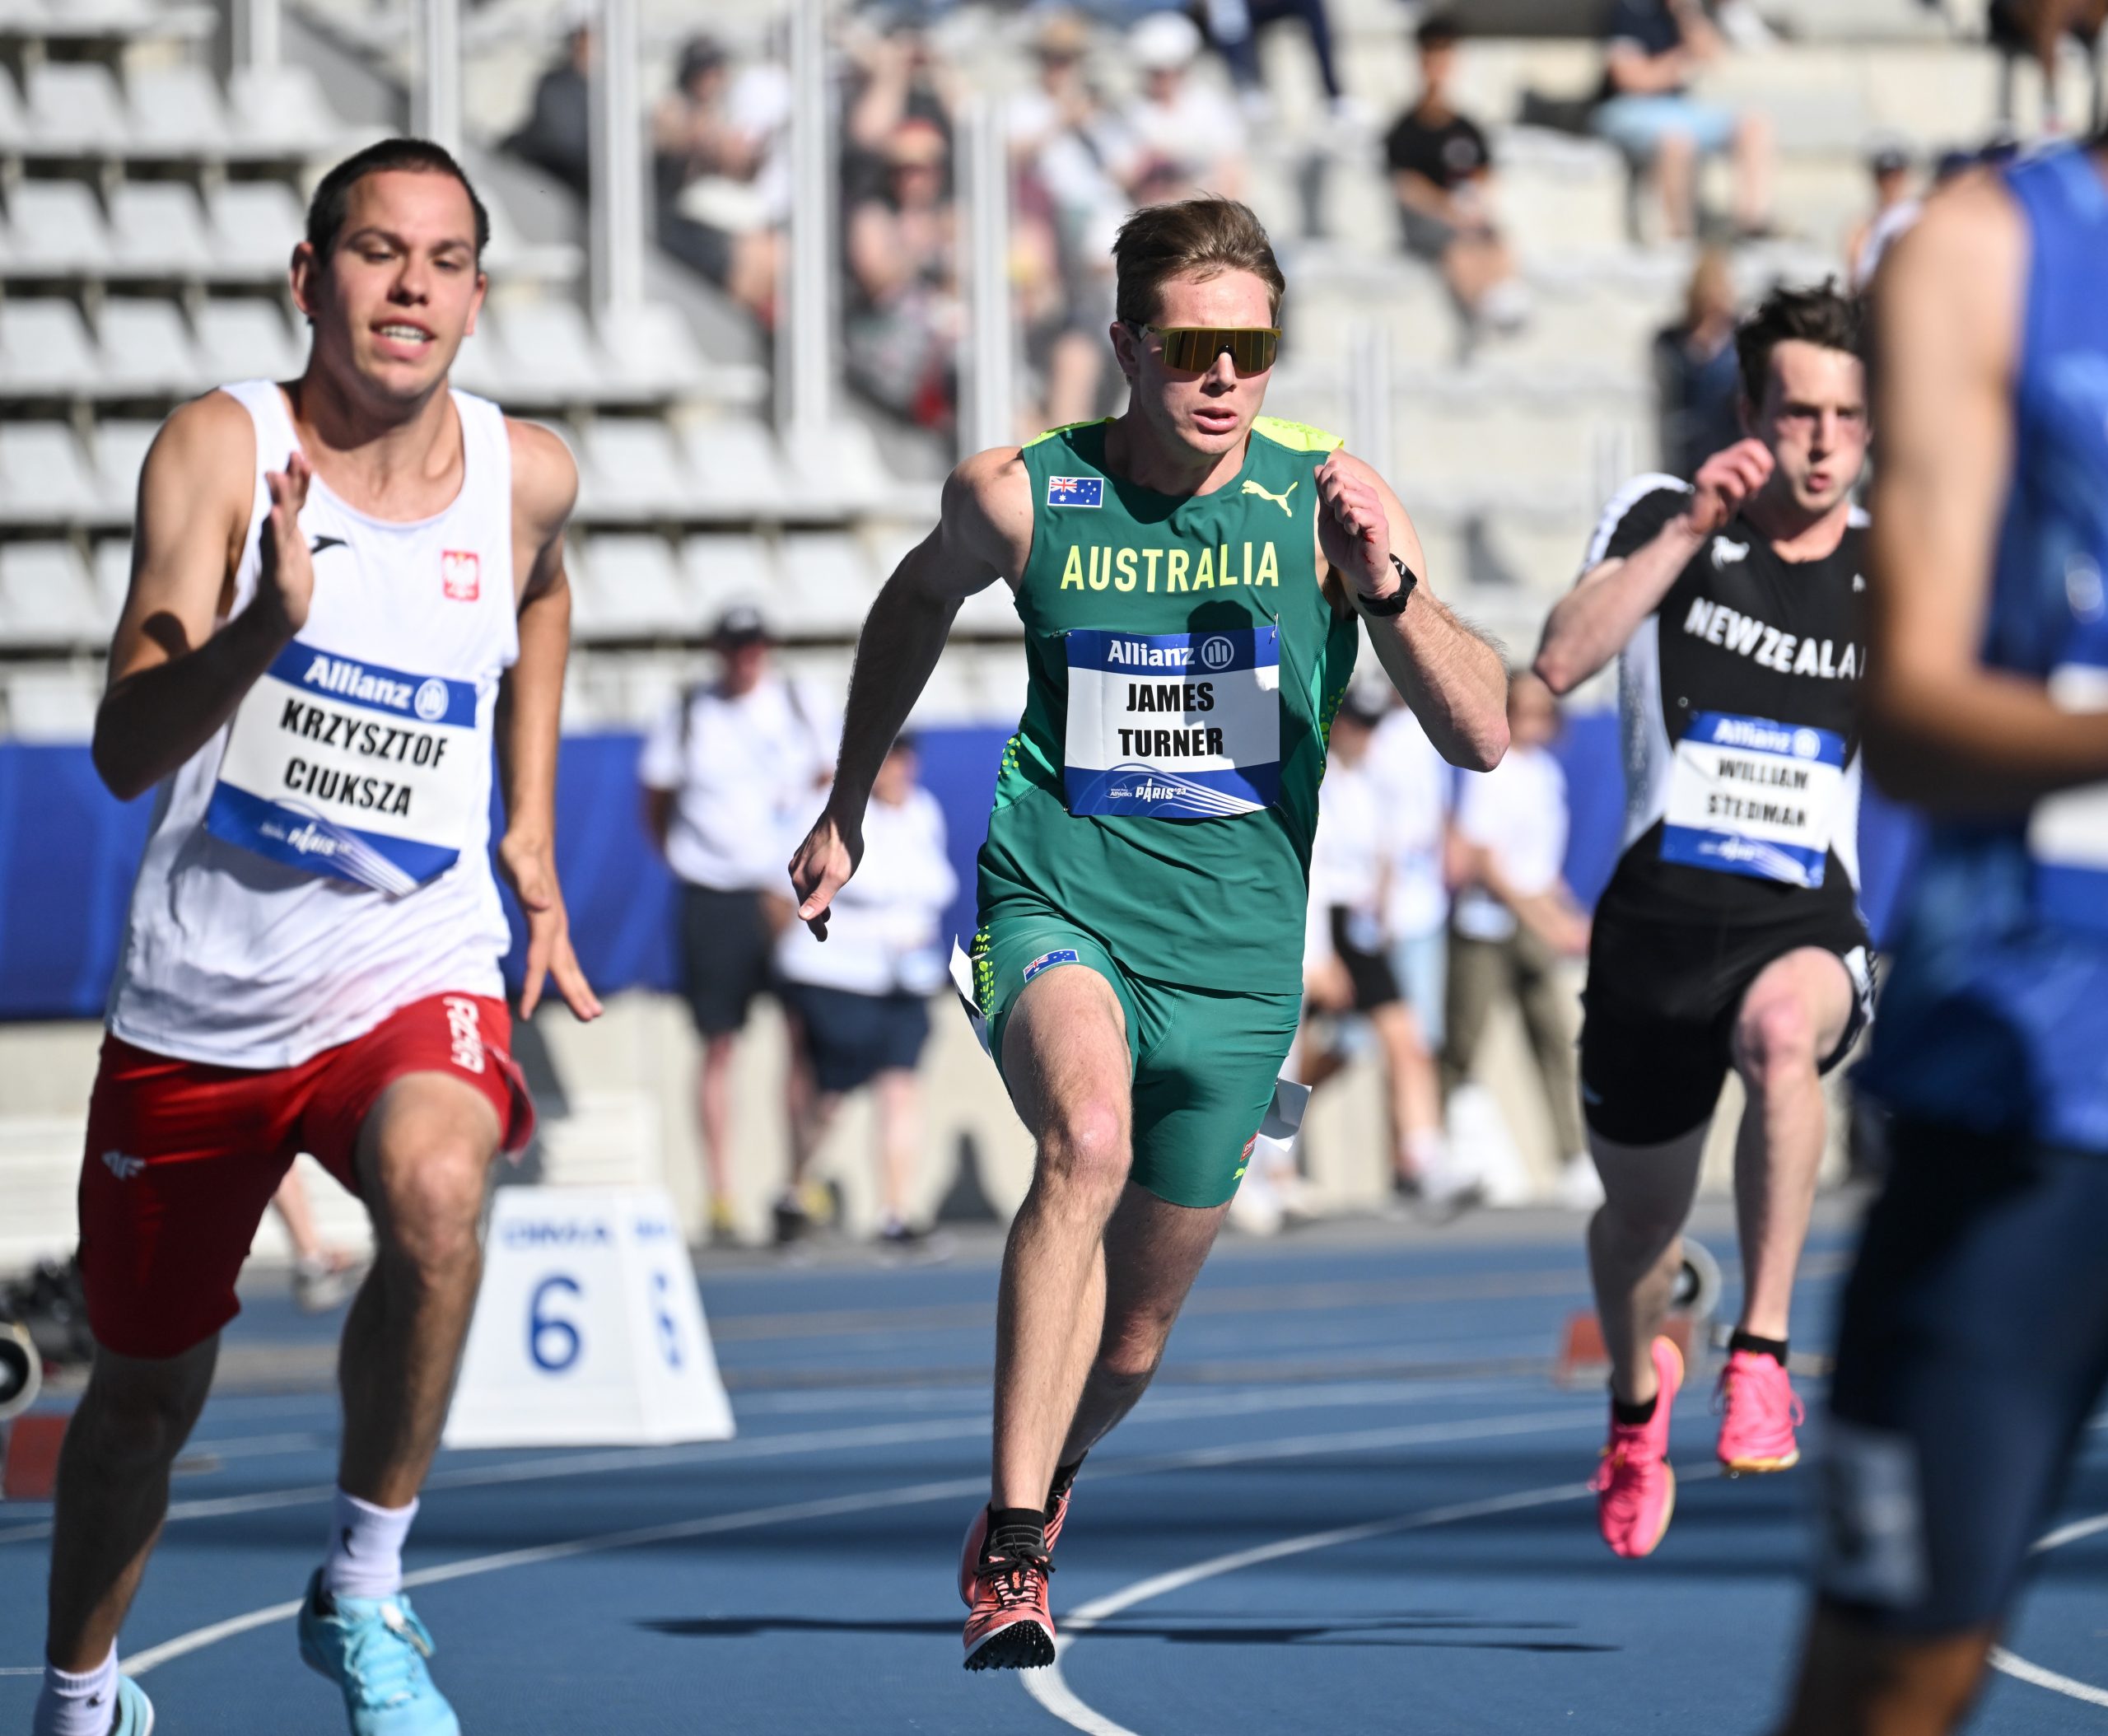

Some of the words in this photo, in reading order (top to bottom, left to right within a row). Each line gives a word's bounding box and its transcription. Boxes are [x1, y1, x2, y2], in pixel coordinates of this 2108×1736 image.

[1060, 541, 1279, 593] AUSTRALIA
[1108, 639, 1195, 666] Allianz
[303, 654, 414, 710] Allianz
[1126, 682, 1214, 712] JAMES
[280, 698, 449, 768] KRZYSZTOF
[1117, 727, 1224, 757] TURNER
[284, 756, 413, 817] CIUKSZA
[528, 1271, 581, 1373] 6
